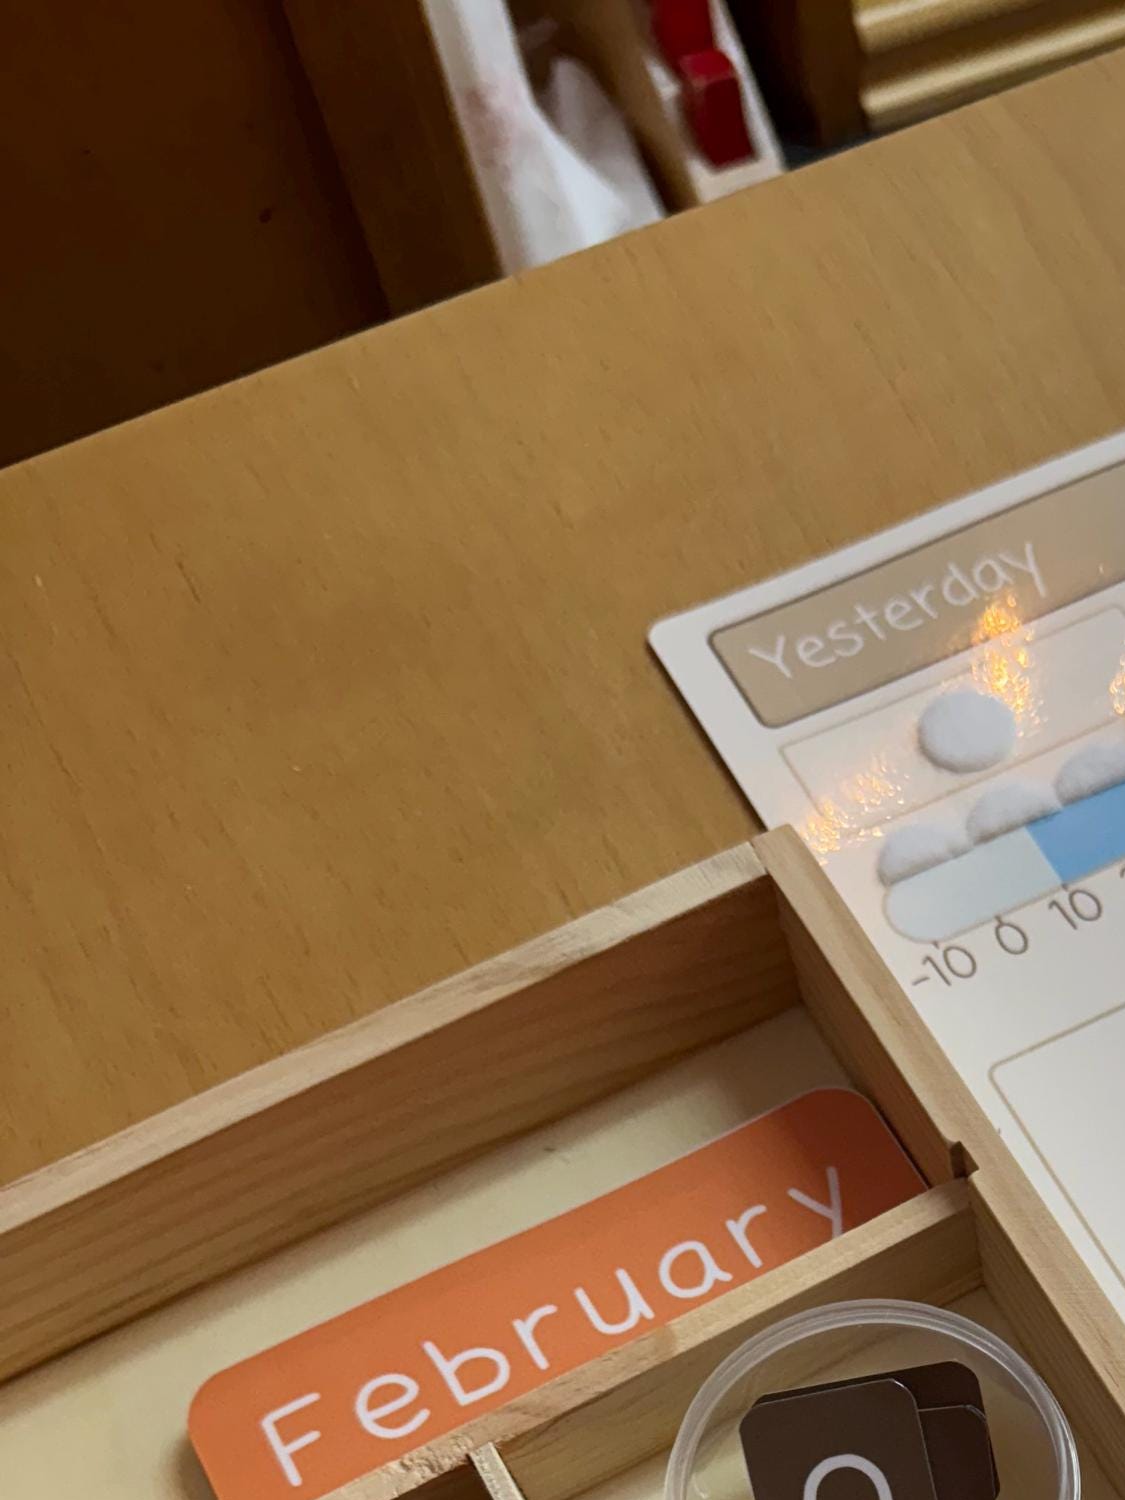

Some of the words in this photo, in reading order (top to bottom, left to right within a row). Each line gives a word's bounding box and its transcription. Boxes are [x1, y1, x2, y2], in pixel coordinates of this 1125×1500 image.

[748, 542, 1047, 682] Yesterday
[911, 944, 977, 987] -10
[995, 919, 1030, 955] 0
[1048, 888, 1103, 930] 10
[259, 1165, 846, 1488] February
